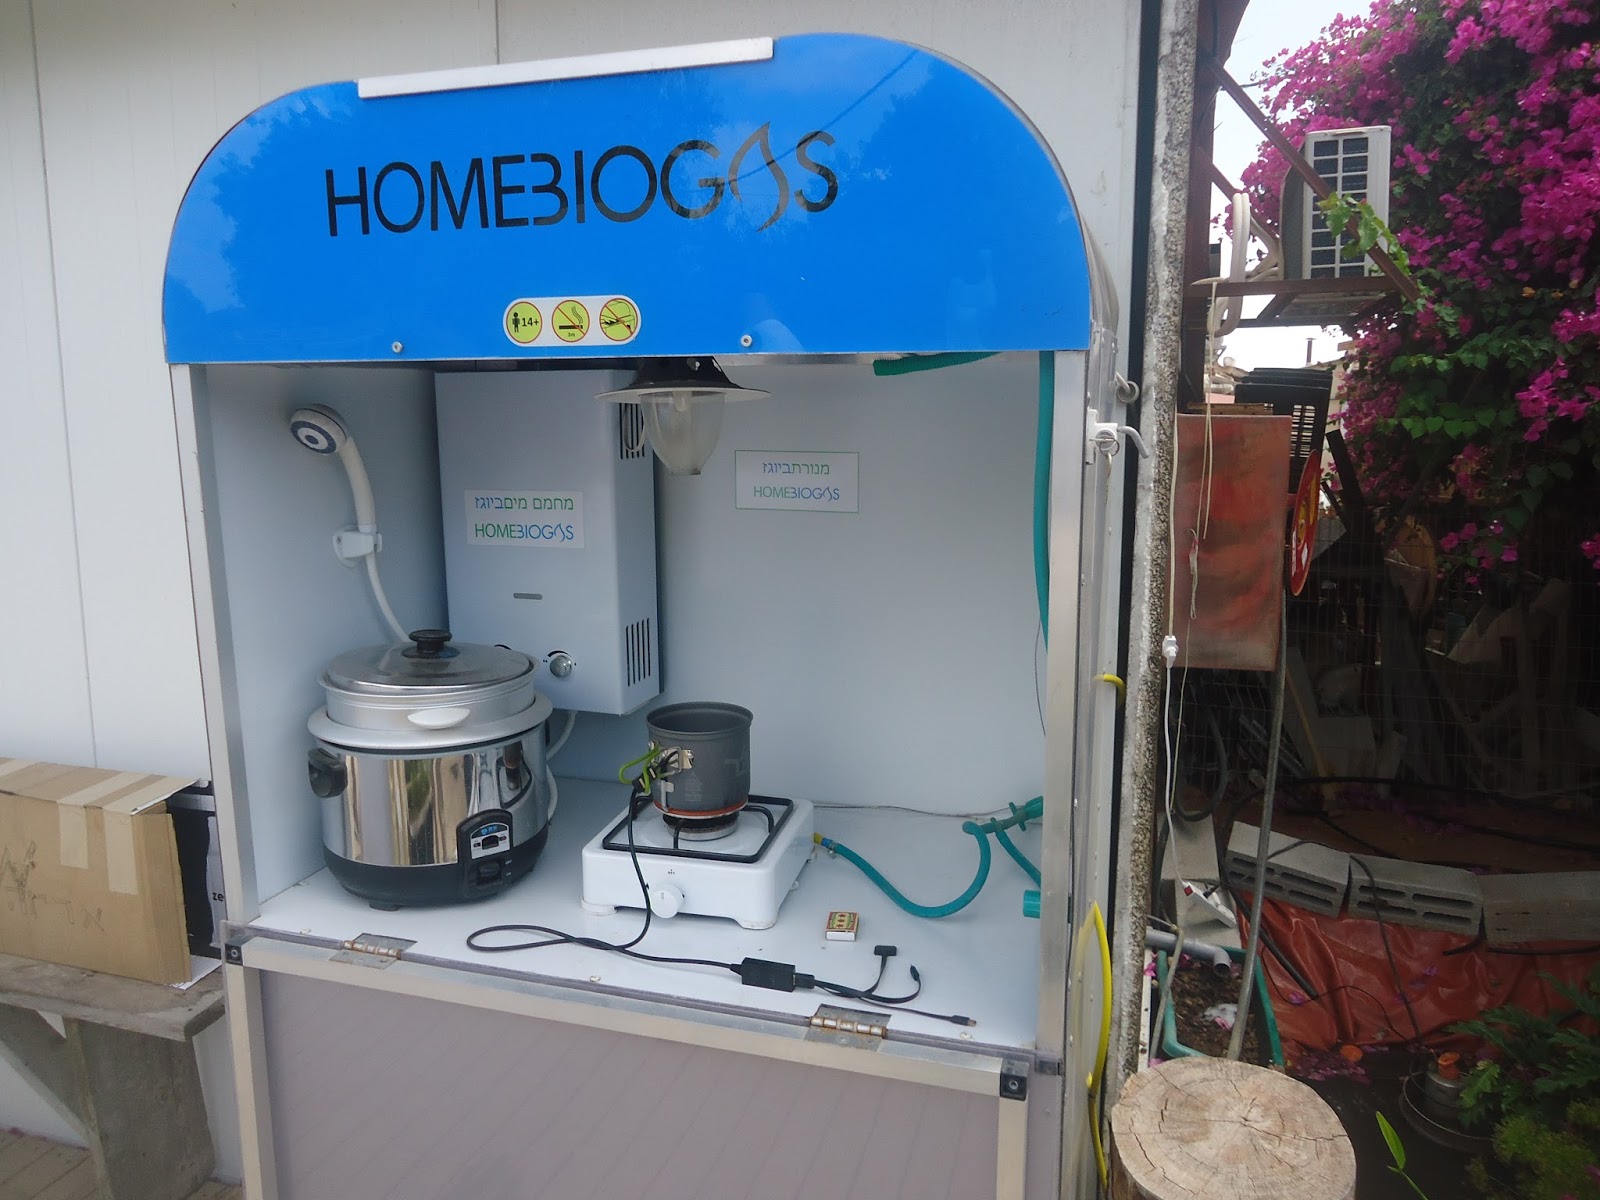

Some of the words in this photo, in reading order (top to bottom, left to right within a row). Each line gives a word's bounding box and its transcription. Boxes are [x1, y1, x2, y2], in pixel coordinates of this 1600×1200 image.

[326, 121, 838, 236] HOMEBIOGAS
[521, 317, 539, 328] 14+
[753, 486, 840, 501] HOMEBIOGAS
[533, 497, 574, 510] מחמם
[474, 523, 574, 542] HOMEBIOGAS
